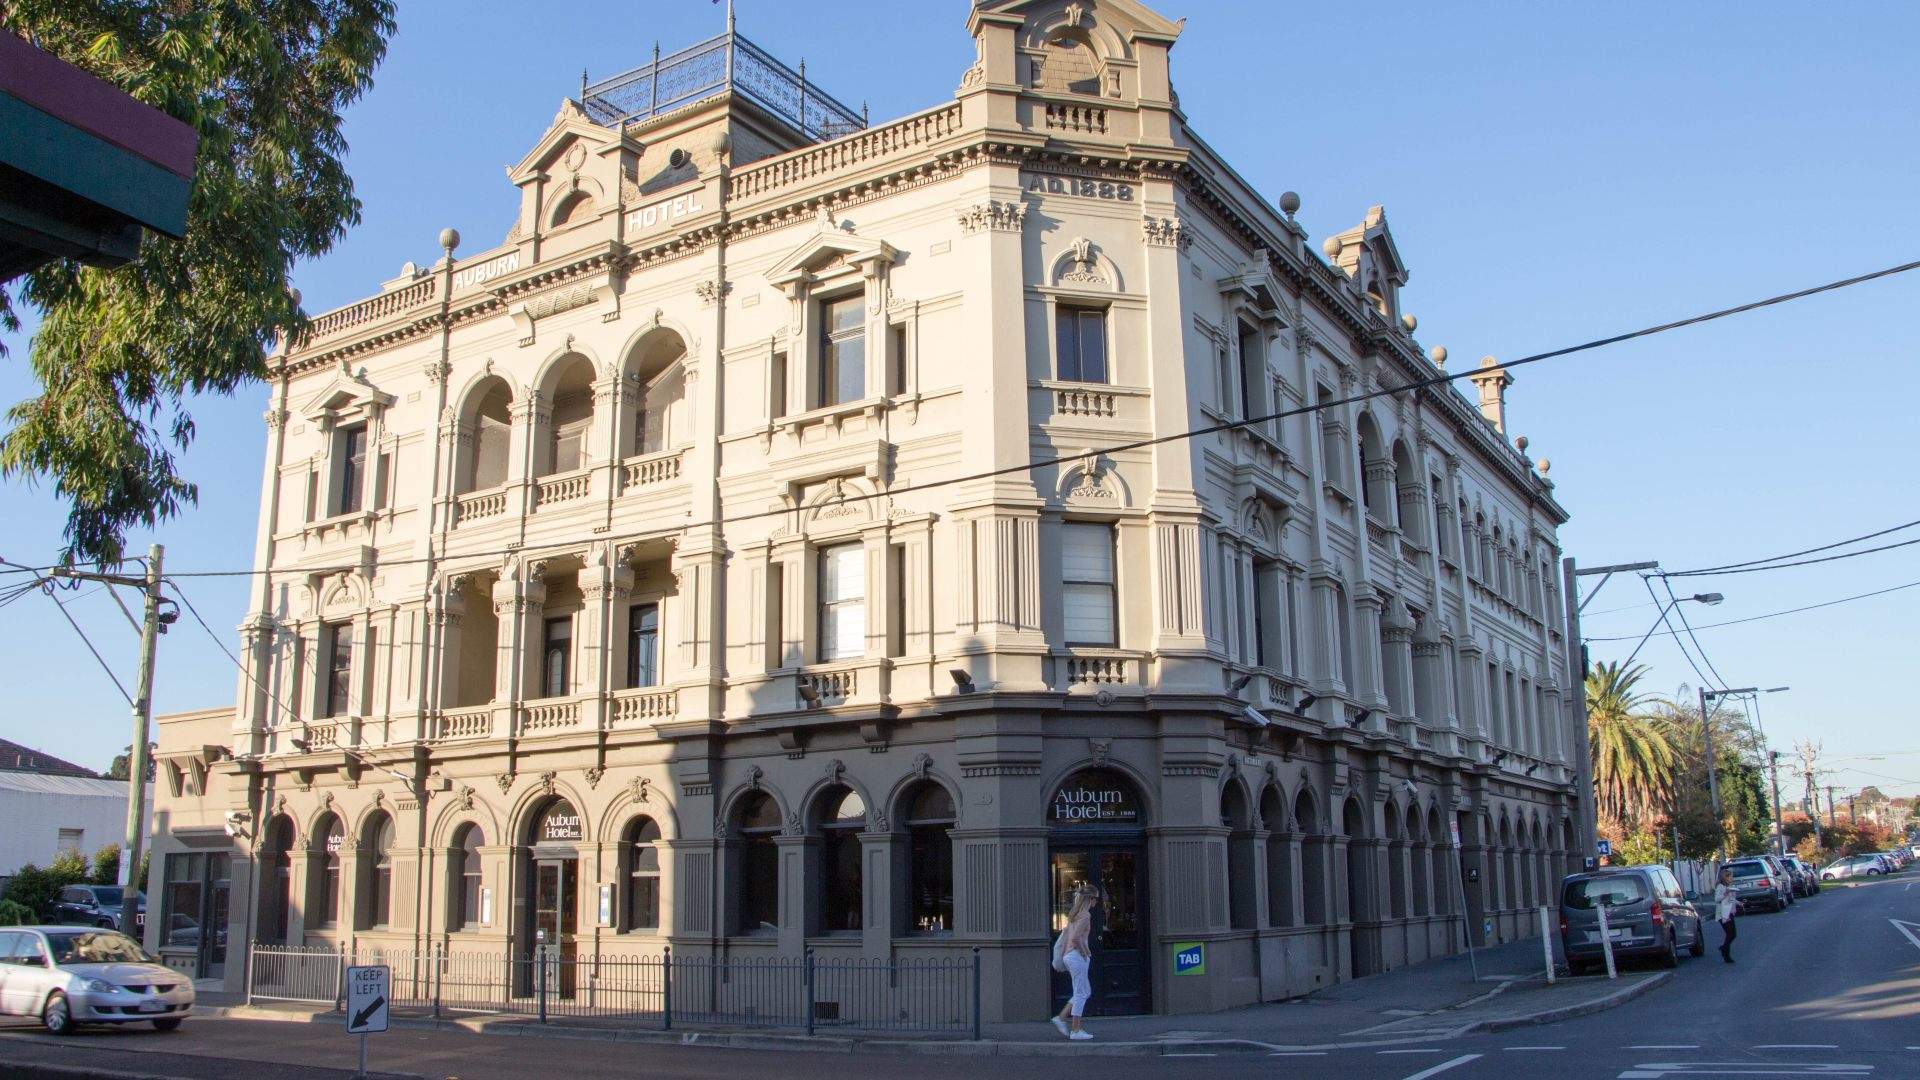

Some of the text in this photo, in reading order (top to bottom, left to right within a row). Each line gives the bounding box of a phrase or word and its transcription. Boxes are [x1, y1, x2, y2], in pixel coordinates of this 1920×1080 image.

[628, 194, 704, 233] HOTEL
[452, 251, 520, 290] AUBURN
[1055, 788, 1122, 803] Auburn
[1055, 803, 1101, 819] Hotel
[546, 826, 571, 838] Hotel
[1178, 953, 1201, 965] TAB
[355, 970, 383, 981] KEEP
[356, 983, 382, 995] LEFT
